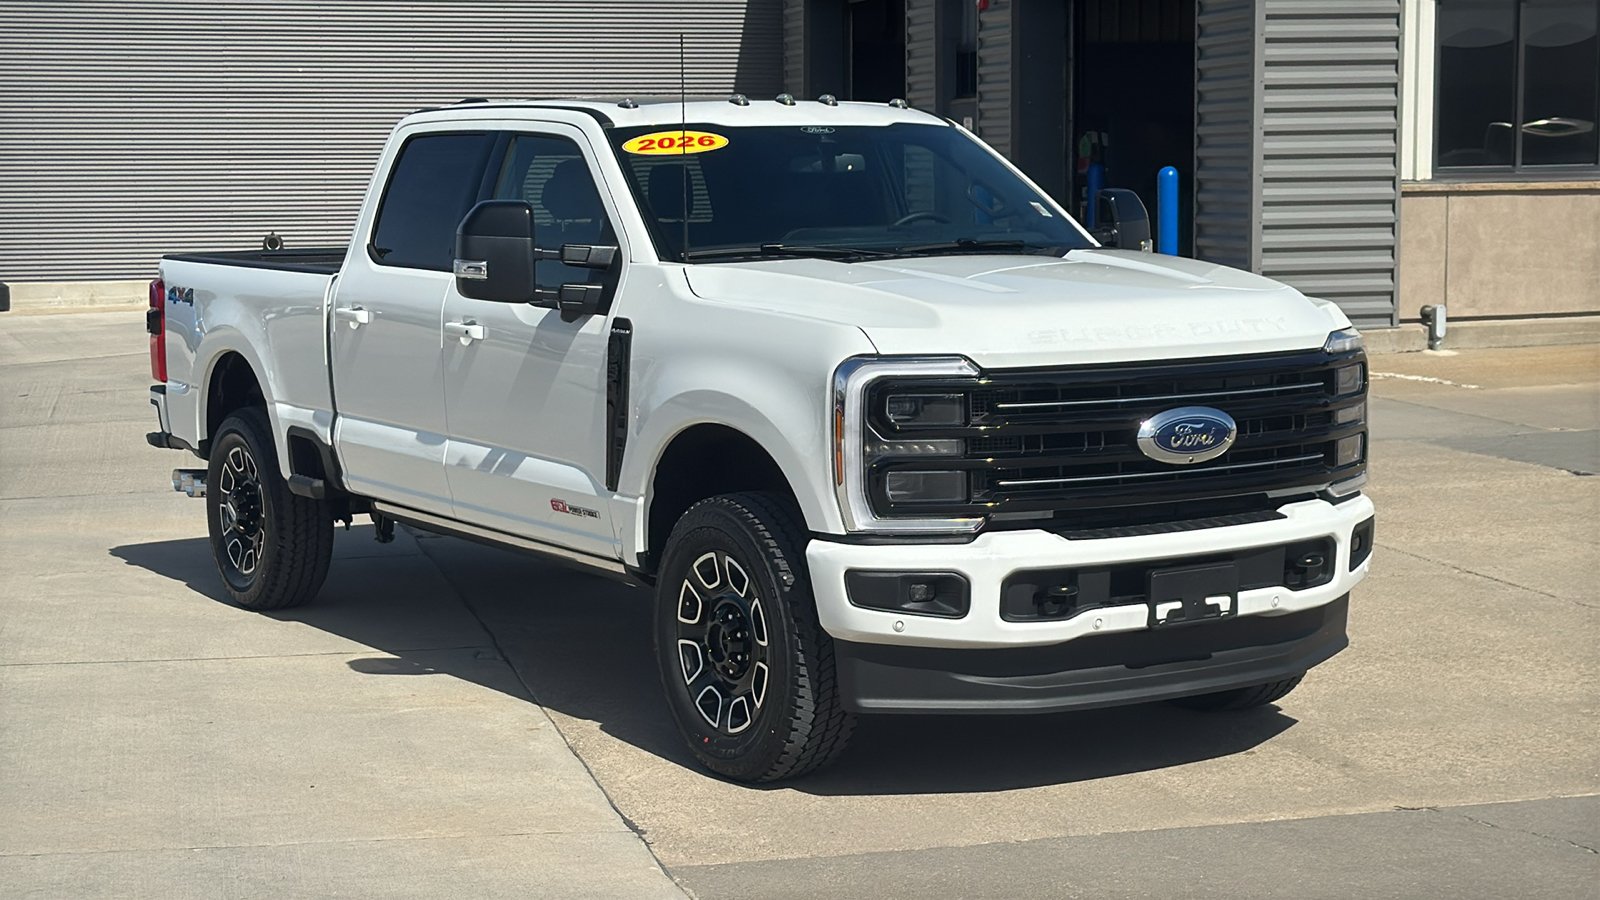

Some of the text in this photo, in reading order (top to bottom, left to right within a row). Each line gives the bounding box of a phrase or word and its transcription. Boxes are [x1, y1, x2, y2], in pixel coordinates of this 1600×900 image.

[637, 136, 717, 151] 2026
[1028, 316, 1288, 344] SUPER DUTY
[1170, 422, 1217, 448] Ford
